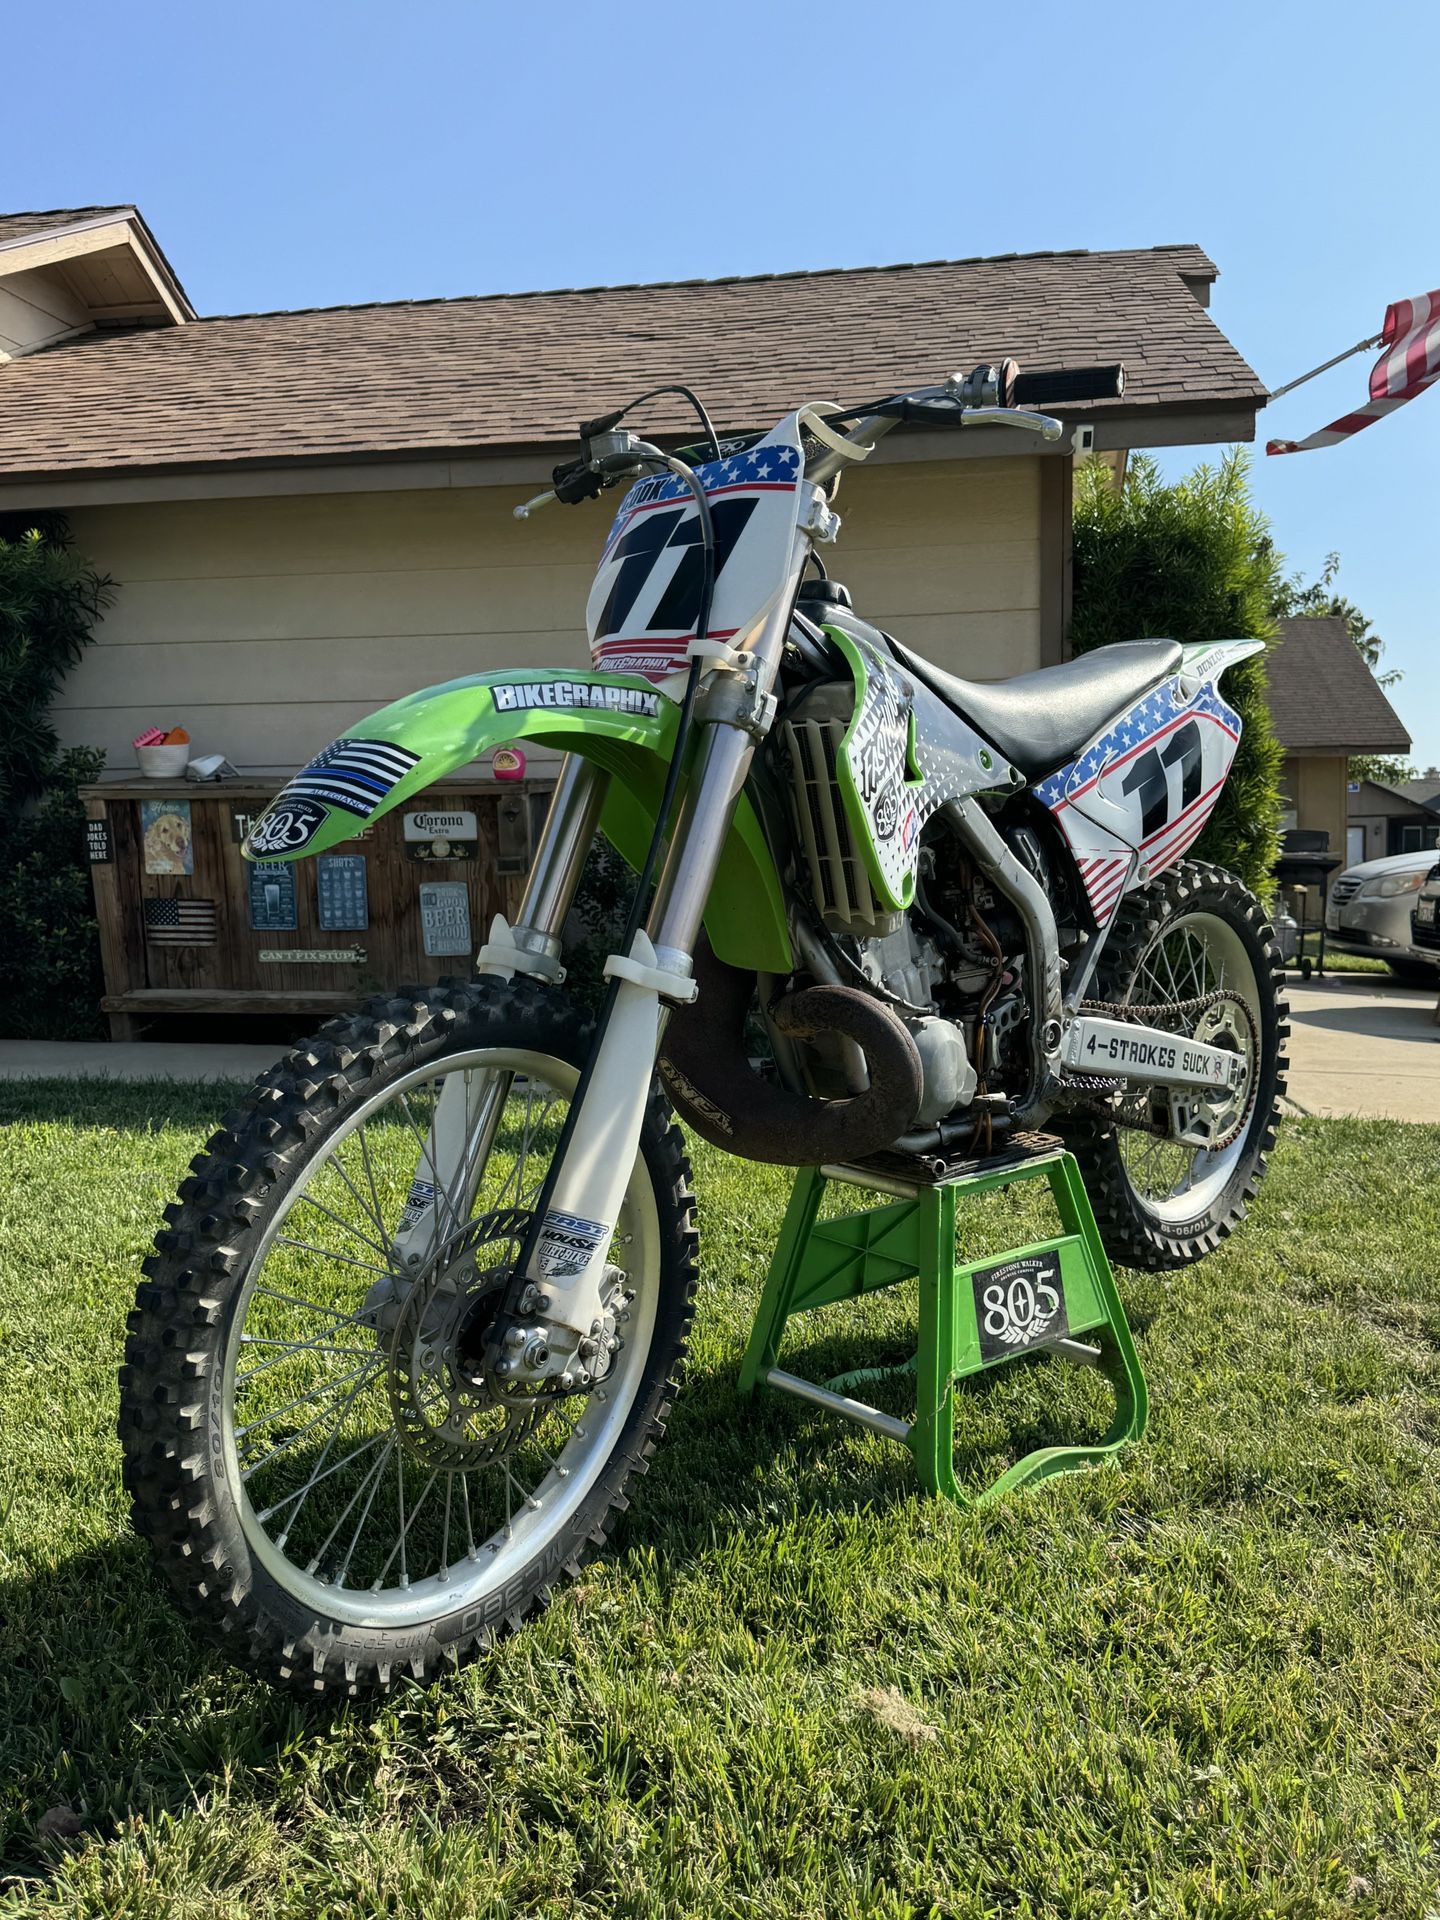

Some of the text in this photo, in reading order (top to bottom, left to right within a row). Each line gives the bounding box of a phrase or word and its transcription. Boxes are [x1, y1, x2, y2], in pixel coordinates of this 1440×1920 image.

[598, 657, 670, 671] BIKEGRAPHIX
[1196, 648, 1226, 677] DUNLOP
[493, 682, 658, 715] BIKEGRAPHIX
[88, 823, 103, 832] DAD
[250, 812, 319, 844] 805
[413, 813, 464, 831] Corona
[429, 826, 450, 834] Extra
[87, 832, 108, 841] JOKES
[89, 841, 107, 850] TOLD
[89, 851, 108, 860] HERE
[256, 861, 288, 871] BEER
[424, 906, 468, 928] BEER
[296, 952, 317, 960] FIX
[319, 952, 361, 960] STUPI
[1087, 1034, 1177, 1069] 4-STROKES
[1183, 1052, 1211, 1075] SUCK
[545, 1213, 608, 1235] FAST
[542, 1230, 600, 1251] HOUSE
[991, 1259, 1044, 1282] FIRESTONE WALKER
[983, 1269, 1060, 1335] 805
